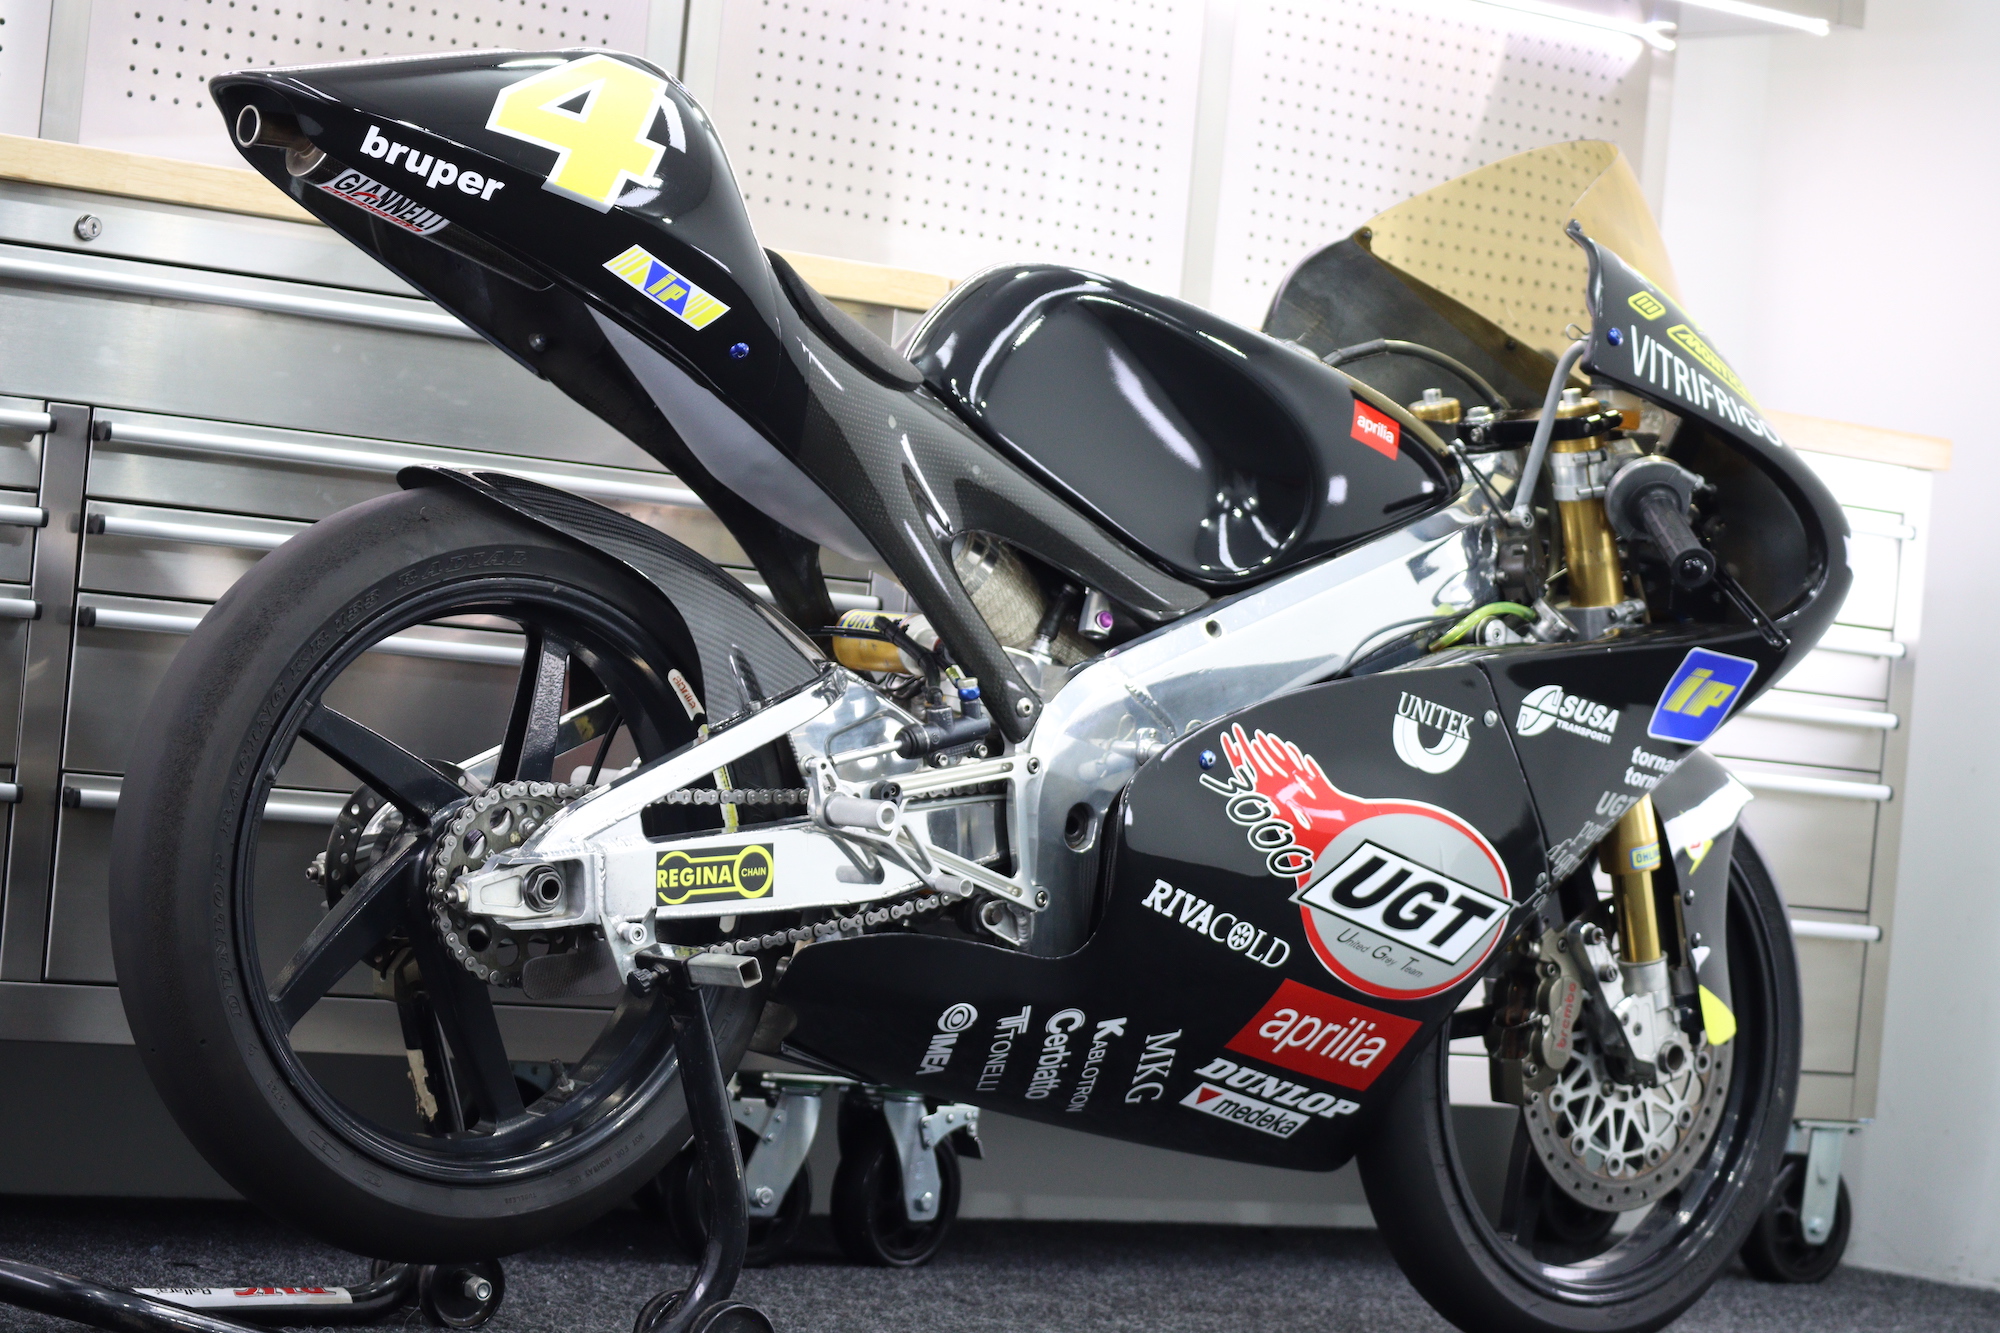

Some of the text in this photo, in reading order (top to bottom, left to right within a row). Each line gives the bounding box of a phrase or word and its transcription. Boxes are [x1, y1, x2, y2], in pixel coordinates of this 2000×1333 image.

[359, 124, 506, 201] bruper
[486, 53, 669, 214] 4
[333, 173, 446, 231] GIANNELLI
[1630, 324, 1784, 448] VITRIFRIGO
[1356, 415, 1395, 445] aprilia
[1398, 691, 1475, 741] UNITEK
[1556, 718, 1613, 744] TRANSPORTI
[1559, 695, 1620, 734] SUSA
[1199, 773, 1315, 879] 3000
[656, 864, 767, 889] REGINA CHAIN
[1331, 855, 1500, 951] UGT
[1141, 878, 1291, 969] RIVACOLD
[1336, 927, 1371, 953] United
[1400, 956, 1424, 978] Team
[1257, 1004, 1388, 1072] aprilia
[1556, 981, 1578, 1049] brembo
[1024, 1007, 1086, 1100] Cerbiatto
[1124, 1028, 1183, 1104] MKG
[1194, 1057, 1360, 1120] DUNLOP
[1212, 1095, 1299, 1136] medeka
